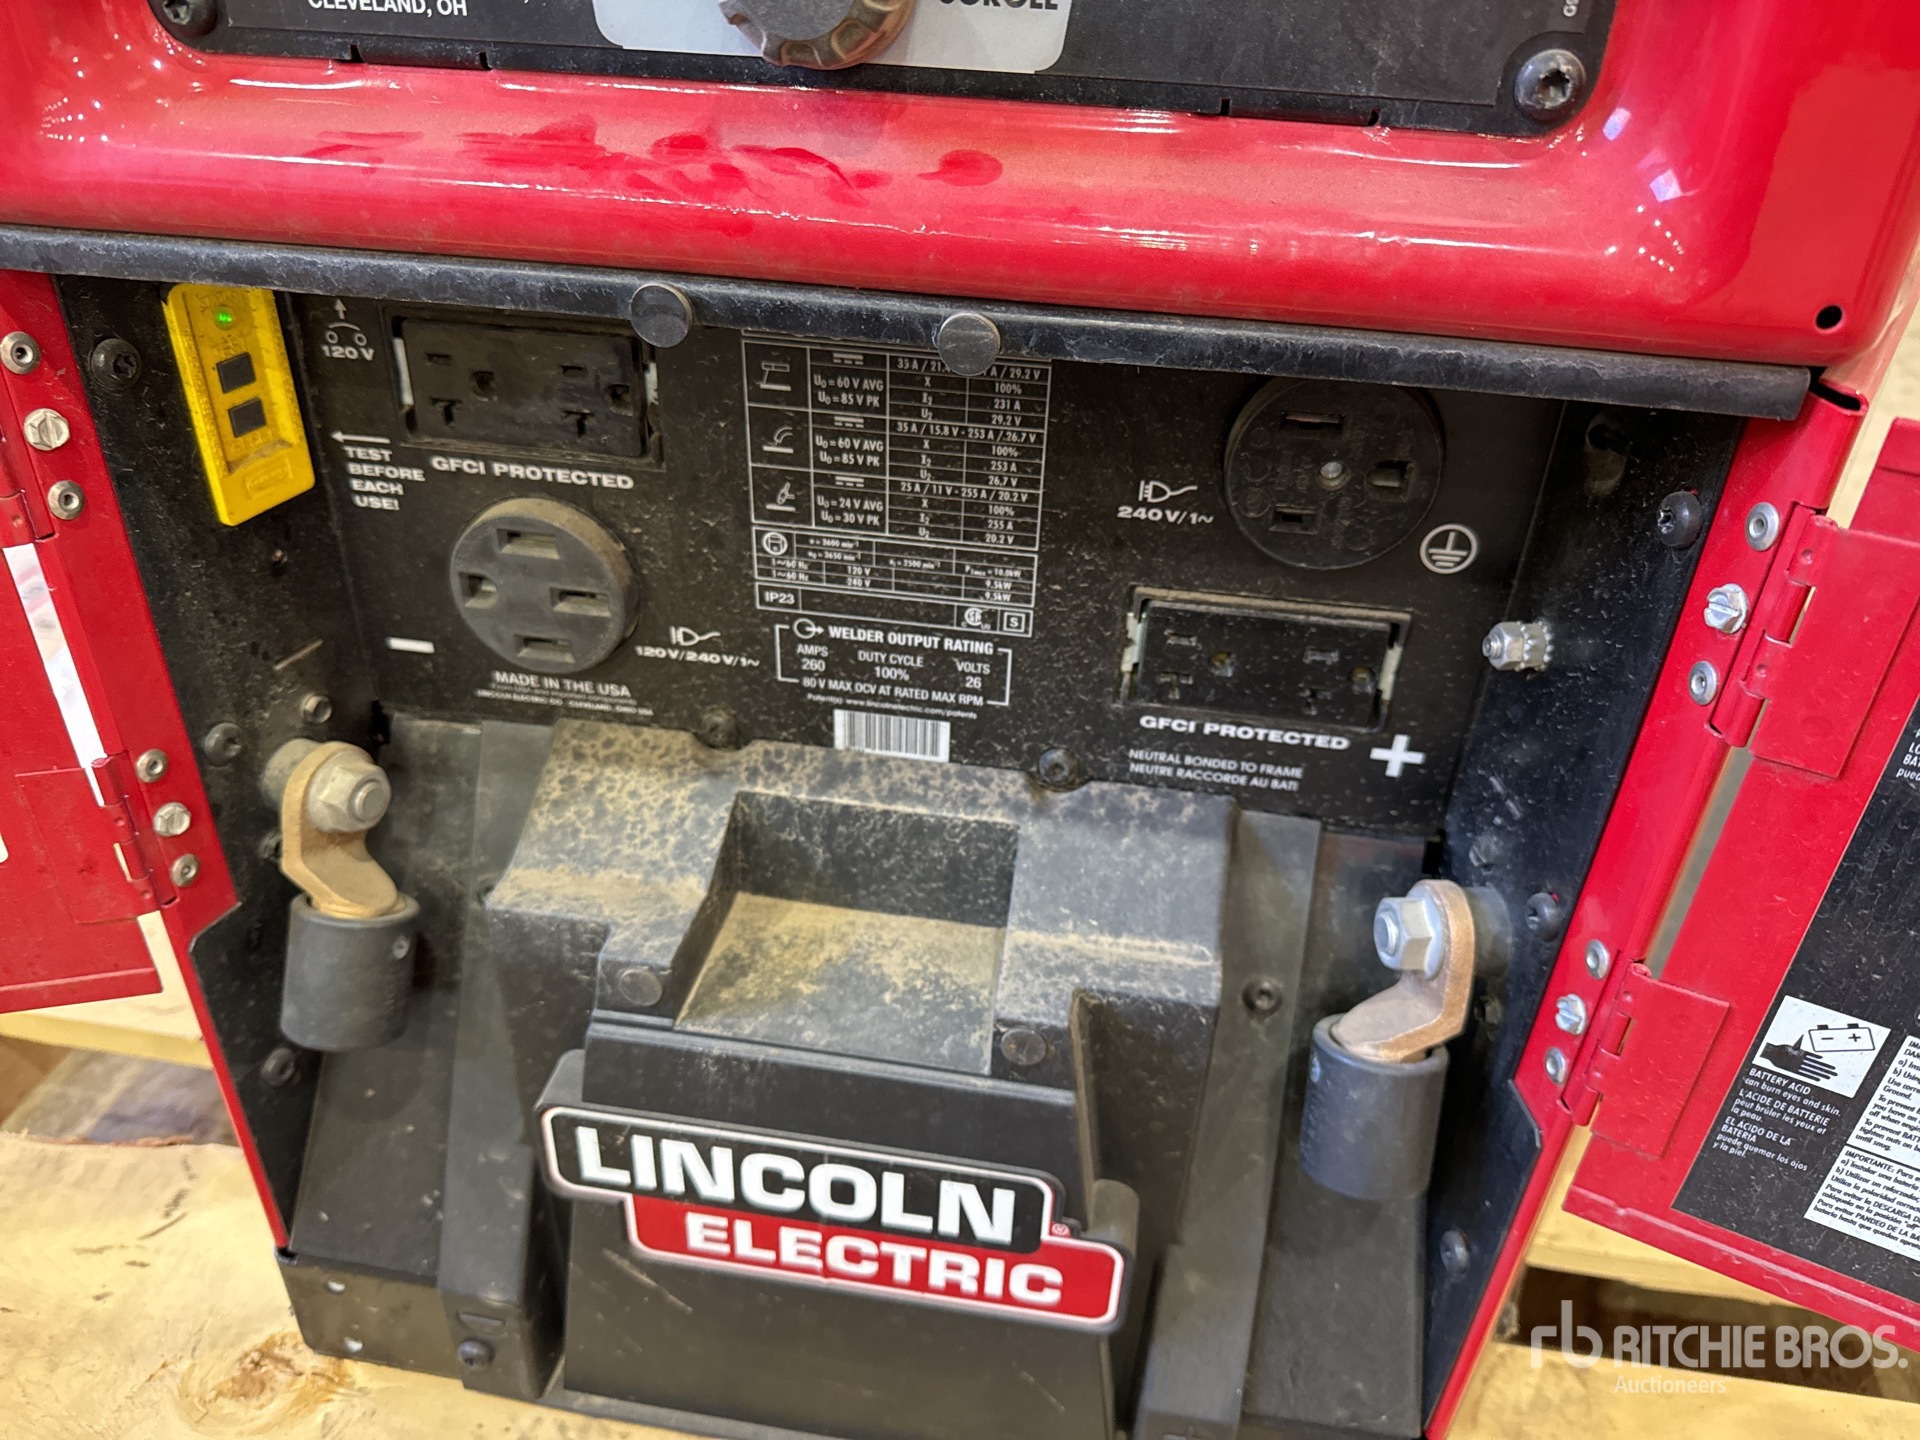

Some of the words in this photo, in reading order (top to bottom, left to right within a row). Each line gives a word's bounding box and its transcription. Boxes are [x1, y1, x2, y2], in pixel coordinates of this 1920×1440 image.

[438, 0, 467, 16] OH
[897, 358, 910, 370] 35
[912, 359, 919, 370] A
[990, 366, 998, 378] A
[1010, 368, 1031, 379] 29.2
[1033, 369, 1041, 380] V
[837, 376, 850, 389] 60
[852, 377, 860, 390] V
[863, 378, 884, 392] AVG
[995, 382, 1022, 395] 100%
[841, 392, 854, 405] 85
[856, 394, 864, 406] V
[866, 395, 880, 408] PK
[994, 398, 1011, 410] 231
[1014, 400, 1021, 411] A
[991, 414, 1012, 426] 29.2
[1014, 415, 1022, 427] V
[897, 422, 909, 433] 35
[911, 423, 918, 434] A
[930, 424, 949, 436] 15.8
[952, 426, 959, 437] V
[968, 428, 985, 439] 253
[987, 429, 995, 440] A
[1006, 430, 1026, 442] 26.7
[1029, 433, 1037, 444] V
[838, 437, 851, 449] 60
[852, 438, 860, 450] V
[863, 440, 884, 452] AVG
[991, 445, 1019, 458] 100%
[343, 446, 392, 462] TEST
[842, 453, 855, 465] 85
[856, 454, 864, 466] V
[866, 455, 880, 467] PK
[347, 463, 425, 481] BEFORE
[430, 455, 486, 475] GFCI
[493, 462, 635, 489] PROTECTED
[990, 460, 1008, 472] 253
[1010, 462, 1017, 473] A
[351, 479, 404, 495] EACH
[988, 475, 1008, 487] 26.7
[1010, 477, 1018, 488] V
[900, 481, 912, 492] 25
[914, 483, 921, 493] A
[932, 484, 943, 495] 11
[945, 485, 953, 496] V
[961, 487, 978, 499] 255
[980, 489, 988, 500] A
[999, 490, 1019, 502] 20.2
[1021, 492, 1029, 503] V
[353, 495, 400, 511] USE!
[839, 496, 852, 509] 24
[853, 497, 861, 510] V
[863, 499, 884, 512] AVG
[988, 504, 1015, 517] 100%
[843, 511, 855, 524] 30
[857, 513, 865, 524] V
[866, 514, 880, 527] PK
[987, 518, 1005, 530] 255
[1006, 520, 1014, 531] A
[985, 533, 1005, 545] 20.2
[1007, 535, 1015, 545] V
[847, 565, 863, 576] 120
[864, 567, 871, 576] V
[847, 577, 863, 588] 240
[864, 579, 871, 588] V
[764, 591, 795, 605] IP23
[1009, 617, 1019, 628] S
[828, 625, 884, 643] WELDER
[888, 632, 941, 650] OUTPUT
[944, 637, 994, 655] RATING
[797, 643, 829, 657] AMPS
[802, 658, 826, 672] 260
[857, 650, 887, 663] DUTY
[889, 654, 924, 668] CYCLE
[874, 666, 910, 681] 100%
[956, 661, 991, 675] VOLTS
[492, 671, 540, 688] MADE
[542, 677, 560, 689] IN
[562, 679, 595, 694] THE
[597, 683, 631, 698] USA
[965, 676, 982, 689] 26
[802, 677, 817, 688] 80
[818, 679, 826, 690] V
[828, 680, 853, 693] MAX
[855, 682, 878, 695] OCV
[878, 685, 892, 696] AT
[894, 686, 929, 700] RATED
[932, 690, 957, 704] MAX
[958, 694, 984, 707] RPM
[1139, 715, 1196, 733] GFCI
[1203, 722, 1350, 750] PROTECTED
[1128, 749, 1181, 766] NEUTRAL
[1184, 755, 1237, 772] BONDED
[1240, 760, 1257, 773] TO
[1259, 764, 1304, 780] FRAME
[1129, 763, 1174, 778] NEUTRE
[1176, 768, 1248, 787] RACCORDE
[1250, 777, 1268, 789] AU
[1749, 1067, 1789, 1087] BATTERY
[1788, 1082, 1811, 1096] ACID
[1744, 1077, 1760, 1089] can
[1761, 1081, 1782, 1095] burn
[1782, 1090, 1801, 1103] eyes
[1802, 1098, 1822, 1110] and
[1821, 1103, 1841, 1117] skin.
[1730, 1103, 1740, 1115] la
[1740, 1108, 1763, 1123] peau.
[1738, 1088, 1773, 1106] L'ACIDE
[1773, 1101, 1788, 1112] DE
[1787, 1104, 1831, 1127] BATTERIE
[1734, 1098, 1755, 1110] peut
[1782, 1113, 1794, 1124] les
[1794, 1119, 1816, 1132] yeux
[1816, 1127, 1827, 1135] et
[1724, 1115, 1736, 1126] EL
[1765, 1129, 1778, 1142] DE
[1779, 1135, 1792, 1146] LA
[1716, 1133, 1743, 1148] puede
[1743, 1142, 1776, 1160] quemar
[1776, 1153, 1789, 1165] los
[1789, 1160, 1808, 1172] ojos
[1719, 1142, 1729, 1152] la
[1728, 1145, 1747, 1159] piel.
[575, 1126, 1016, 1246] LINCOLN
[1872, 1201, 1912, 1220] DESCARGA
[1855, 1212, 1886, 1228] PANDEO
[1886, 1223, 1899, 1233] DE
[1898, 1228, 1908, 1237] LA
[684, 1212, 1064, 1306] ELECTRIC
